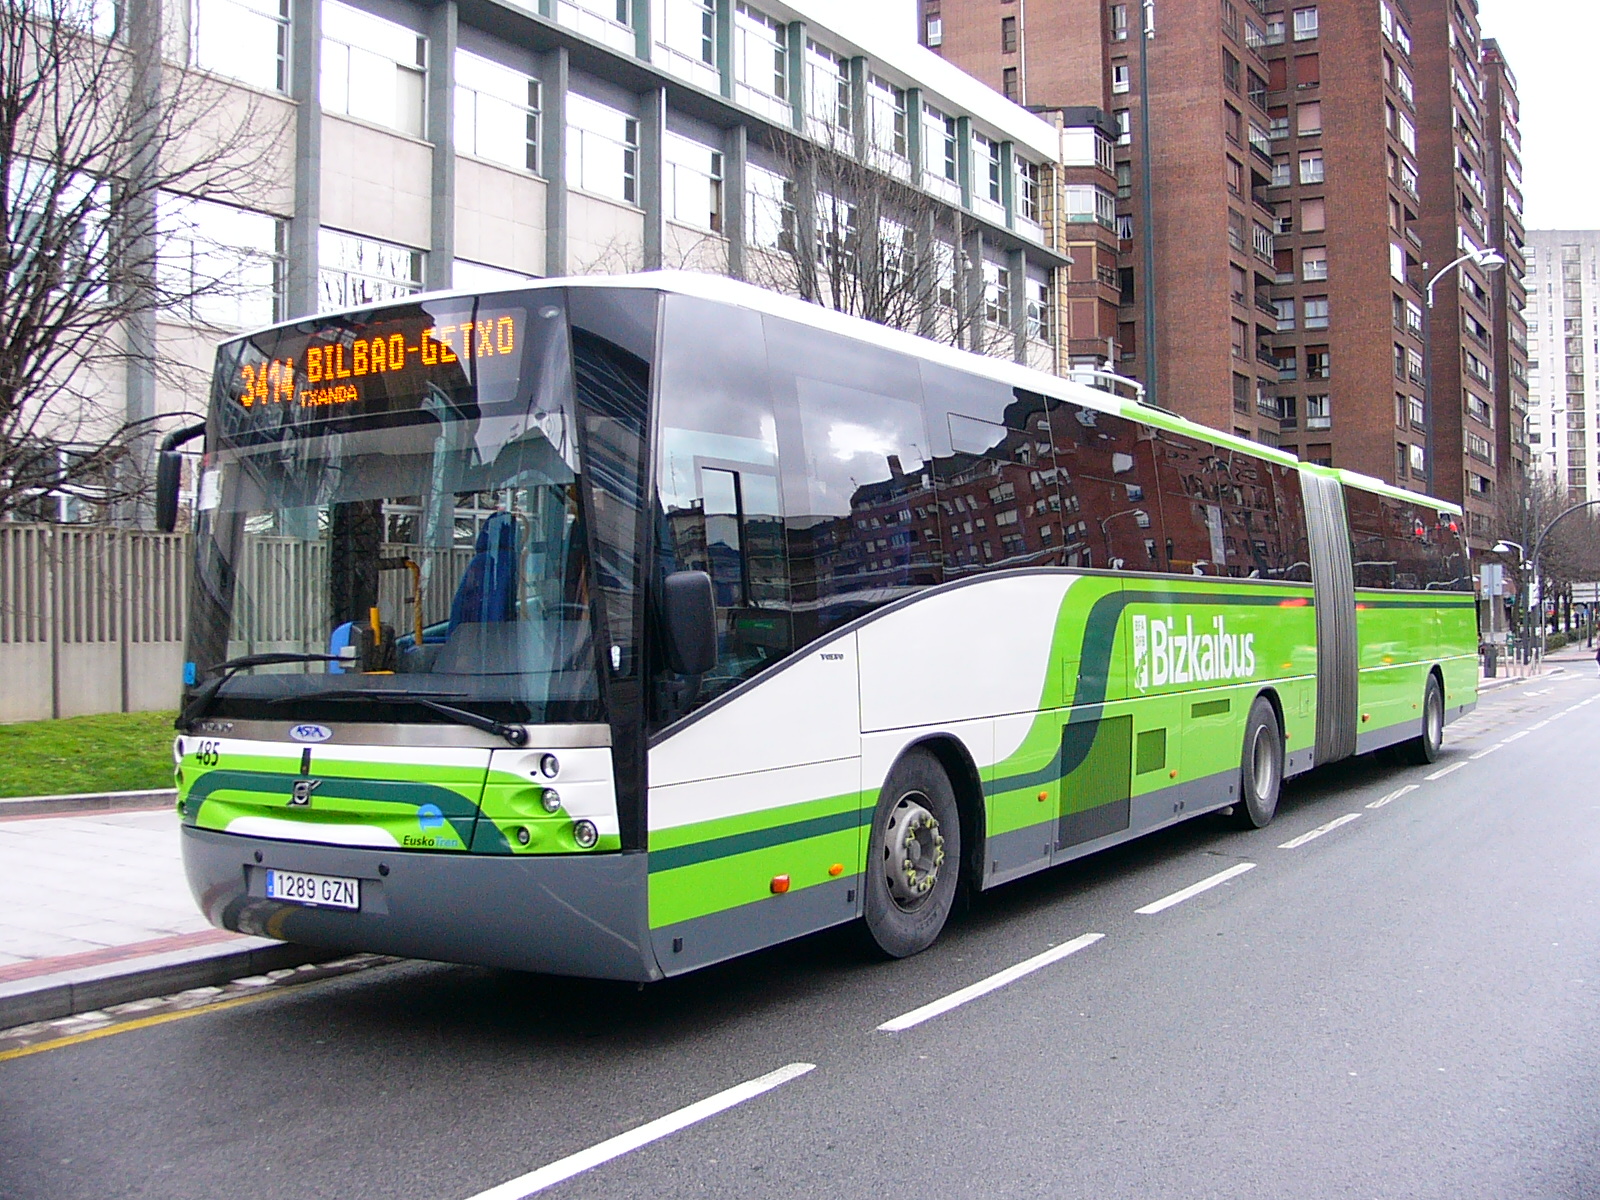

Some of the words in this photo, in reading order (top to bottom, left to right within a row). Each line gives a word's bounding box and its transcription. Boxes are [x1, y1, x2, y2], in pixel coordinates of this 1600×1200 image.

[240, 357, 295, 407] 3414
[307, 316, 513, 382] BILBAO-GETXO
[300, 384, 358, 408] TXANDA
[1150, 614, 1256, 687] Bizkaibus
[196, 741, 220, 767] 485
[279, 874, 315, 899] 1289
[322, 880, 354, 904] GZN
